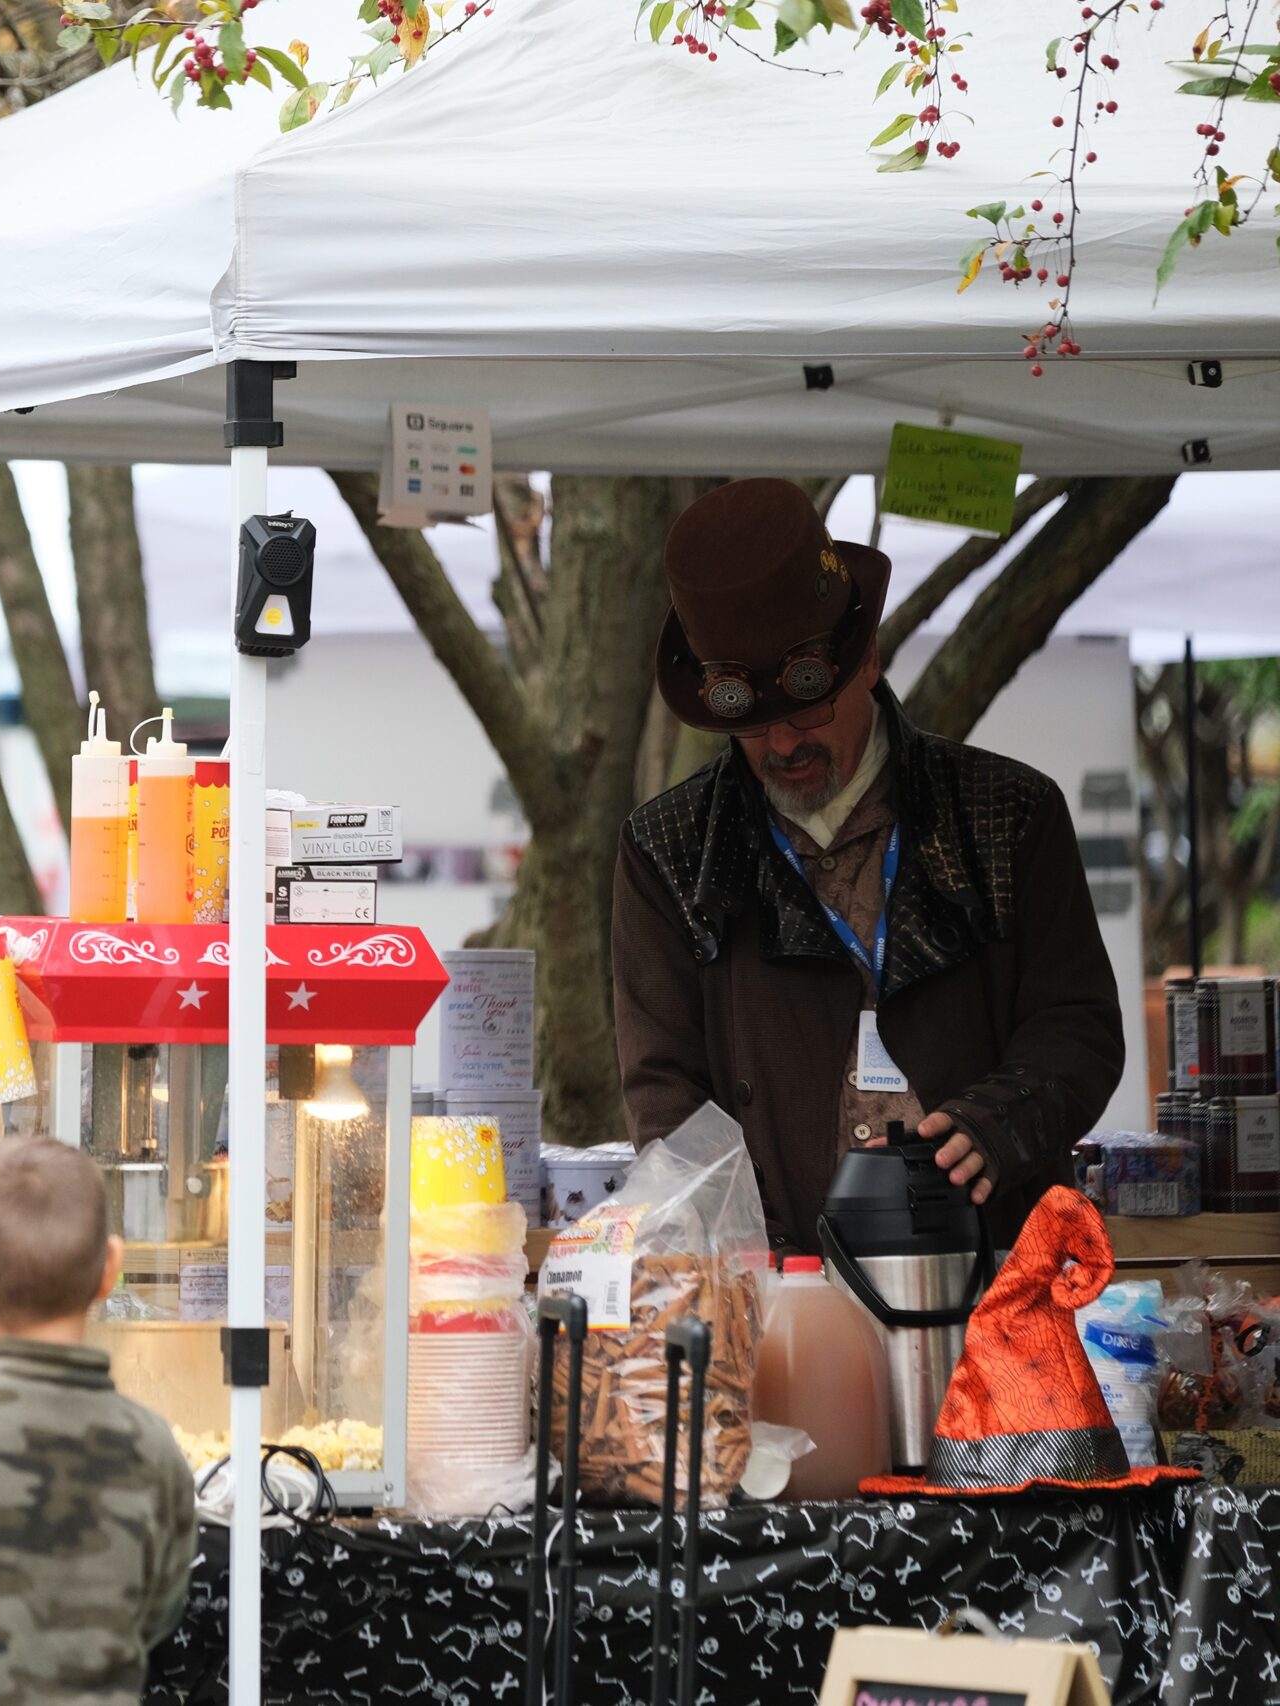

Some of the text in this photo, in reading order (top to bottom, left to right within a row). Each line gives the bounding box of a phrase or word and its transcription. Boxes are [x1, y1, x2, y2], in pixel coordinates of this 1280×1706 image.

[427, 416, 474, 433] Square
[330, 814, 366, 823] FIRM GRIP
[302, 841, 339, 854] VINYL
[342, 840, 392, 853] GLOVES
[343, 870, 372, 878] NITRILE
[278, 886, 288, 897] S
[473, 994, 518, 1011] Thank
[863, 1075, 902, 1085] venmo
[546, 1270, 583, 1285] Cinnamon
